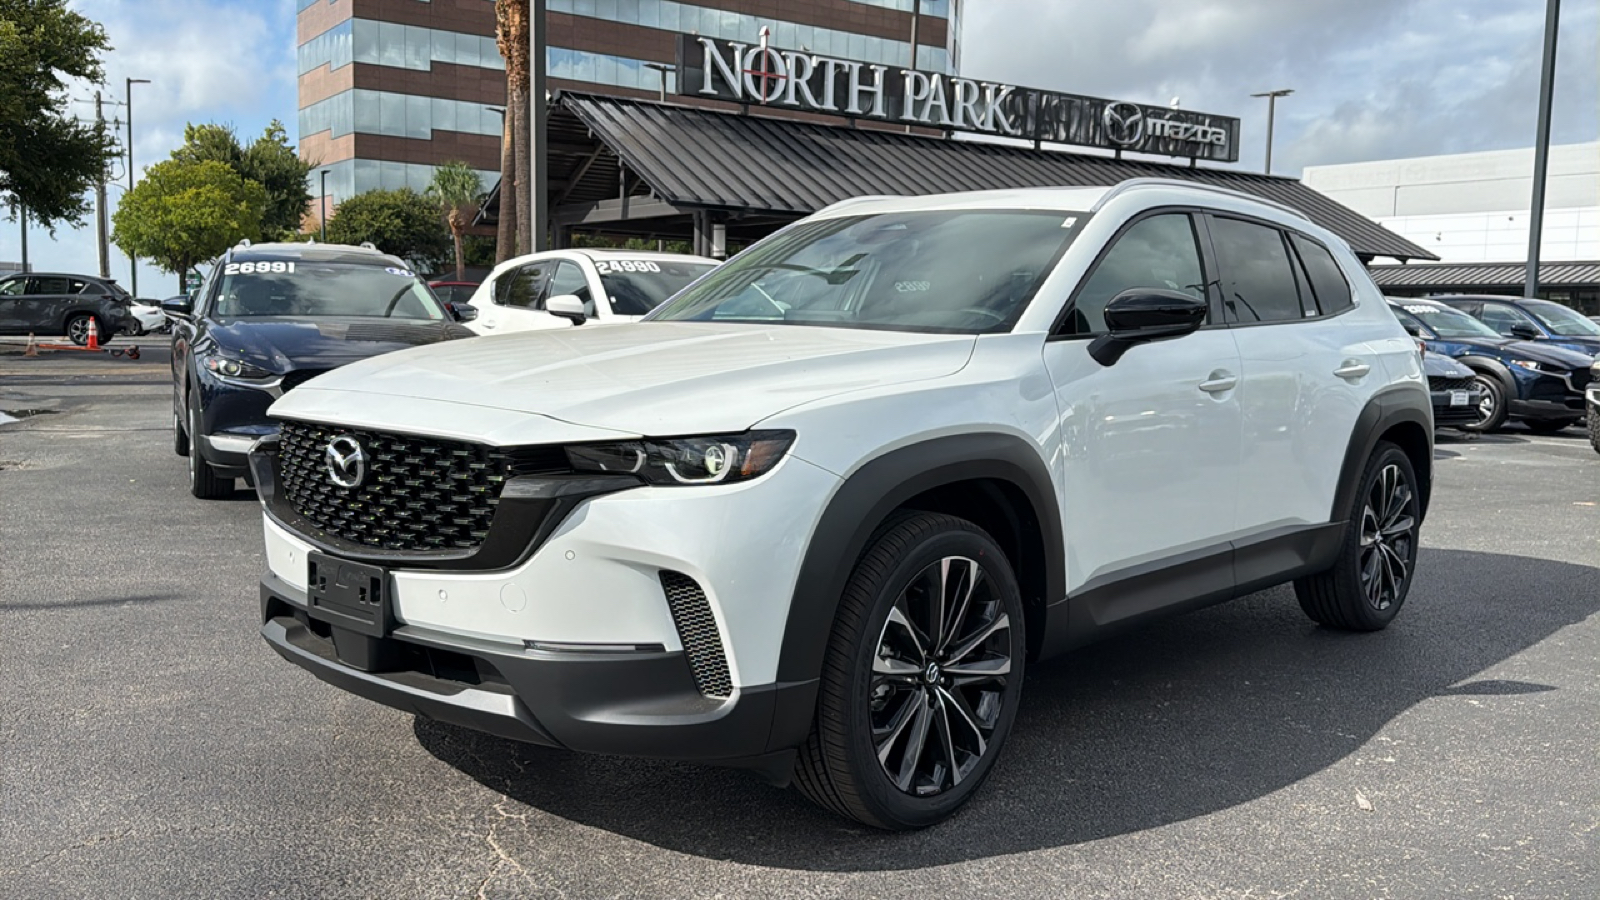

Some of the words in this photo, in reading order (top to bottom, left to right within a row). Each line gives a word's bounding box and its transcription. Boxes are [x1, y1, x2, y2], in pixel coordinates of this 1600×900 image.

[697, 37, 888, 117] NORTH
[900, 70, 1016, 134] PARK
[1146, 118, 1226, 146] mazda
[224, 261, 295, 275] 26991
